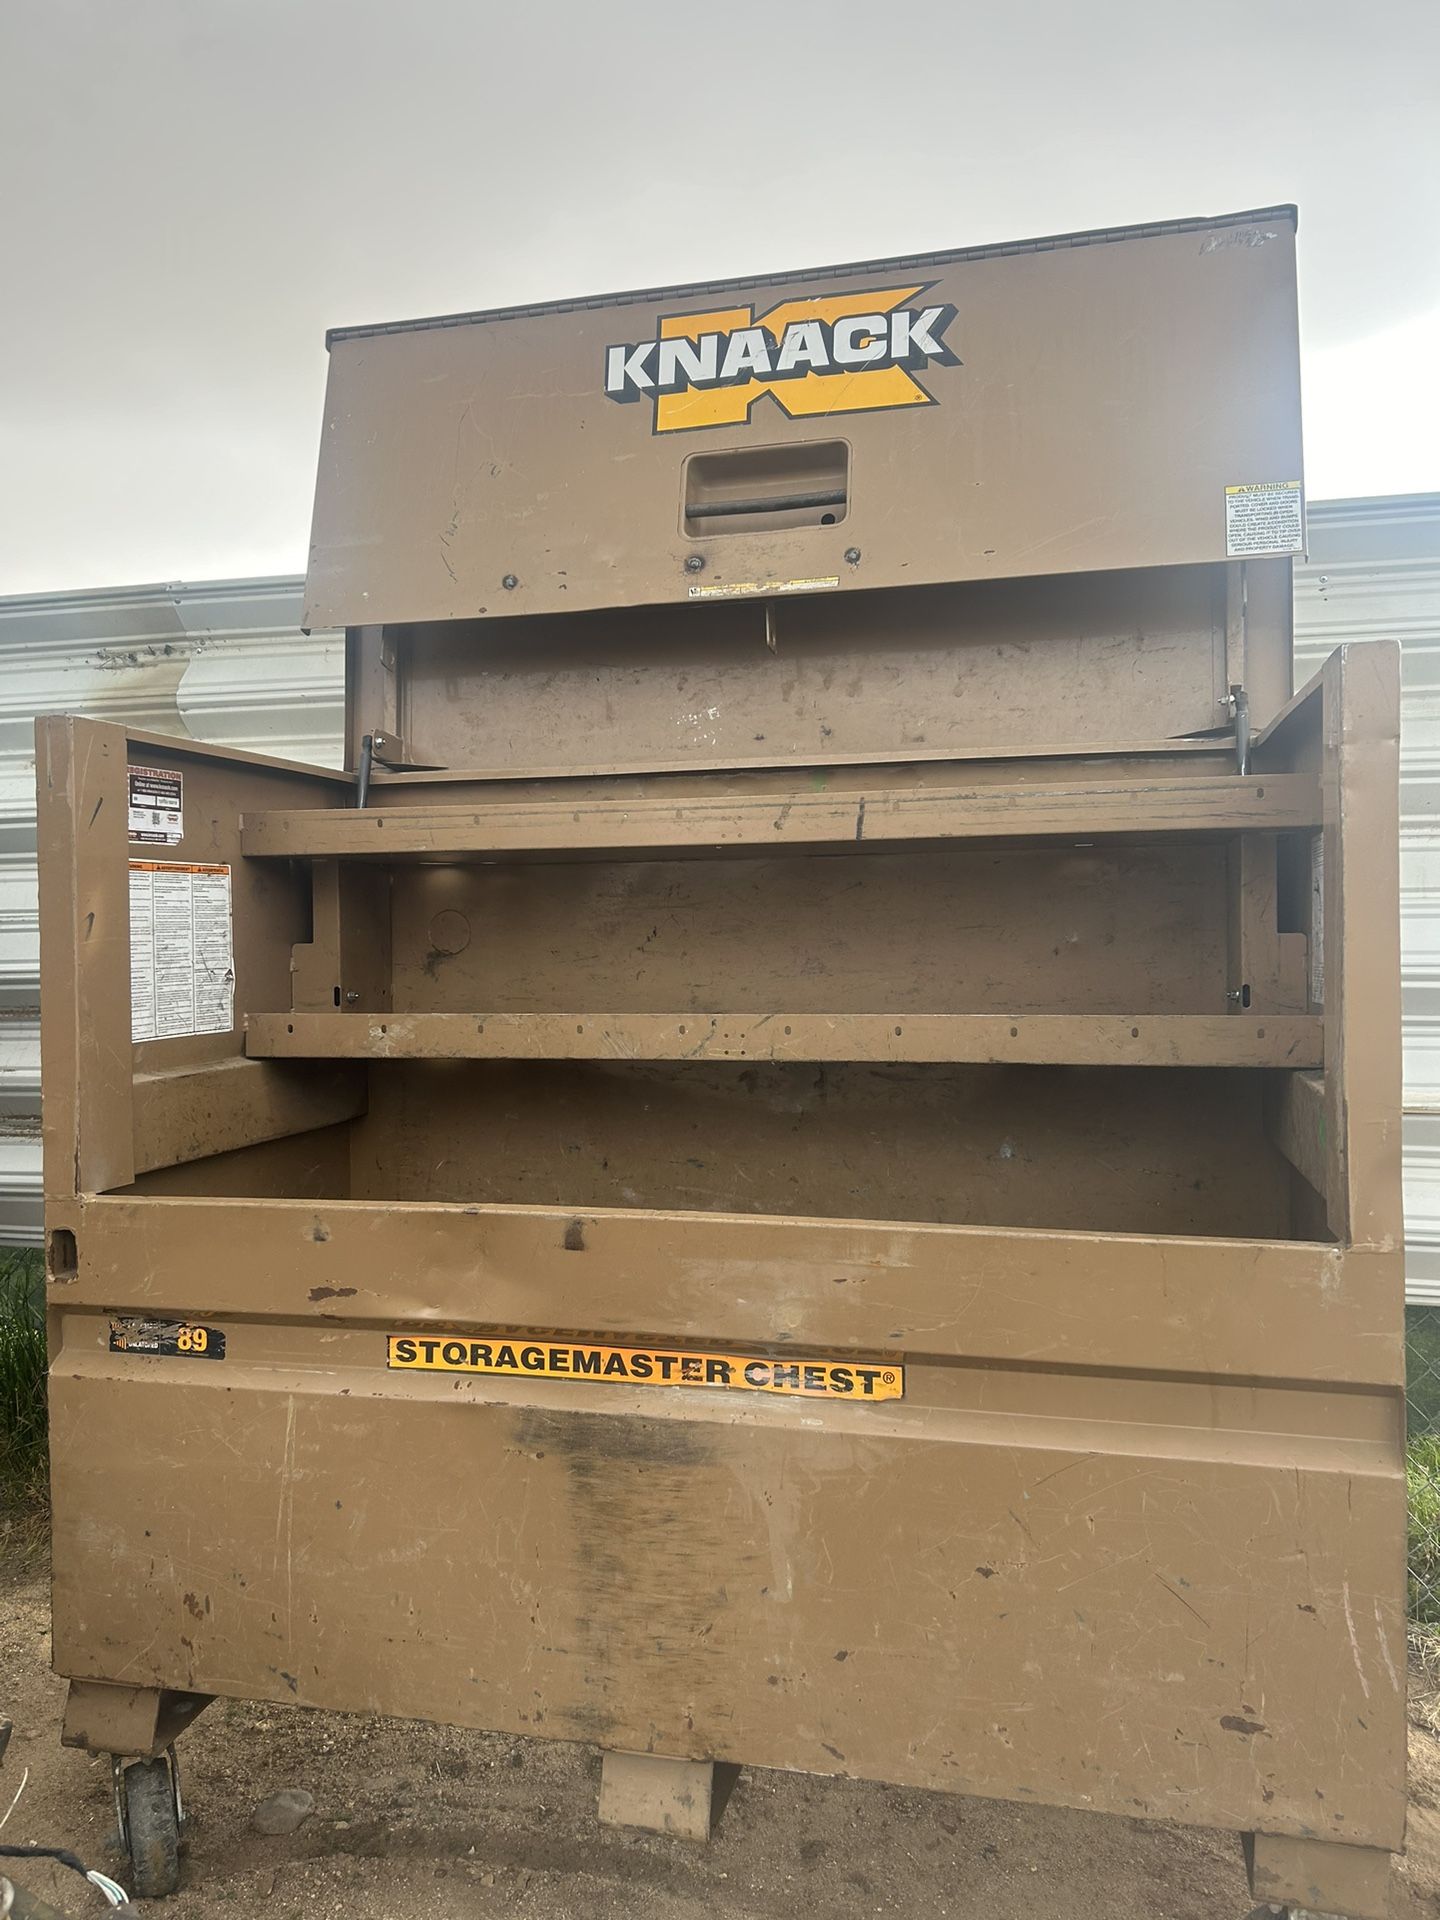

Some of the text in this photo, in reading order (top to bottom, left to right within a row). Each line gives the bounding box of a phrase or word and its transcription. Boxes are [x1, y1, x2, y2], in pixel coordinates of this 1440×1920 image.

[605, 304, 960, 404] KNAACK
[1246, 483, 1288, 491] WARNING
[127, 766, 182, 780] EGISTRATION
[178, 1327, 208, 1352] 89
[396, 1339, 730, 1383] STORAGEMASTER
